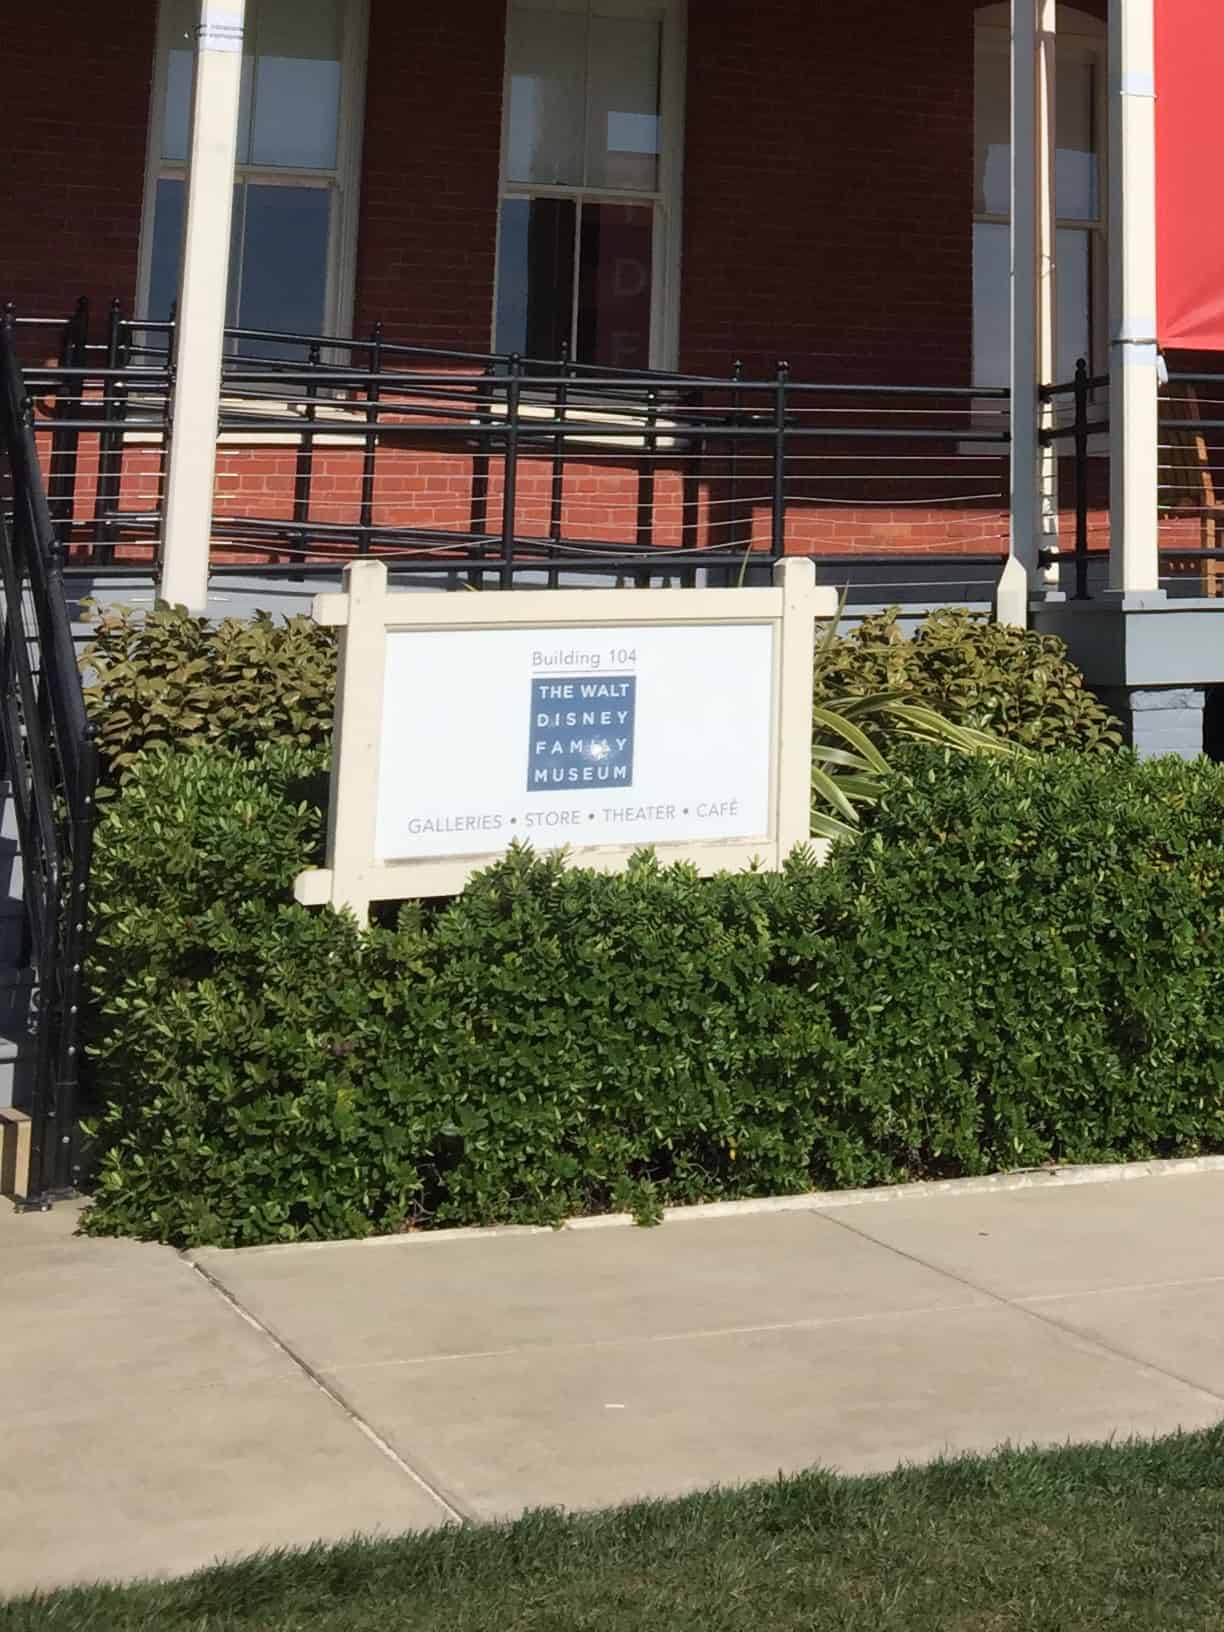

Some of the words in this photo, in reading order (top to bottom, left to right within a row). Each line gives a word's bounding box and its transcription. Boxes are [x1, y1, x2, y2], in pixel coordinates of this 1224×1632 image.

[532, 649, 601, 669] Building
[609, 648, 637, 665] 104
[539, 685, 575, 700] THE
[580, 683, 630, 698] WALT
[536, 711, 628, 727] DISNEY
[535, 737, 627, 756] FAMY
[533, 765, 628, 783] MUSEUM
[407, 814, 503, 835] GALLERIES
[524, 809, 581, 827] STORE
[602, 804, 676, 823] THEATER
[696, 798, 739, 818] CAFÉ
